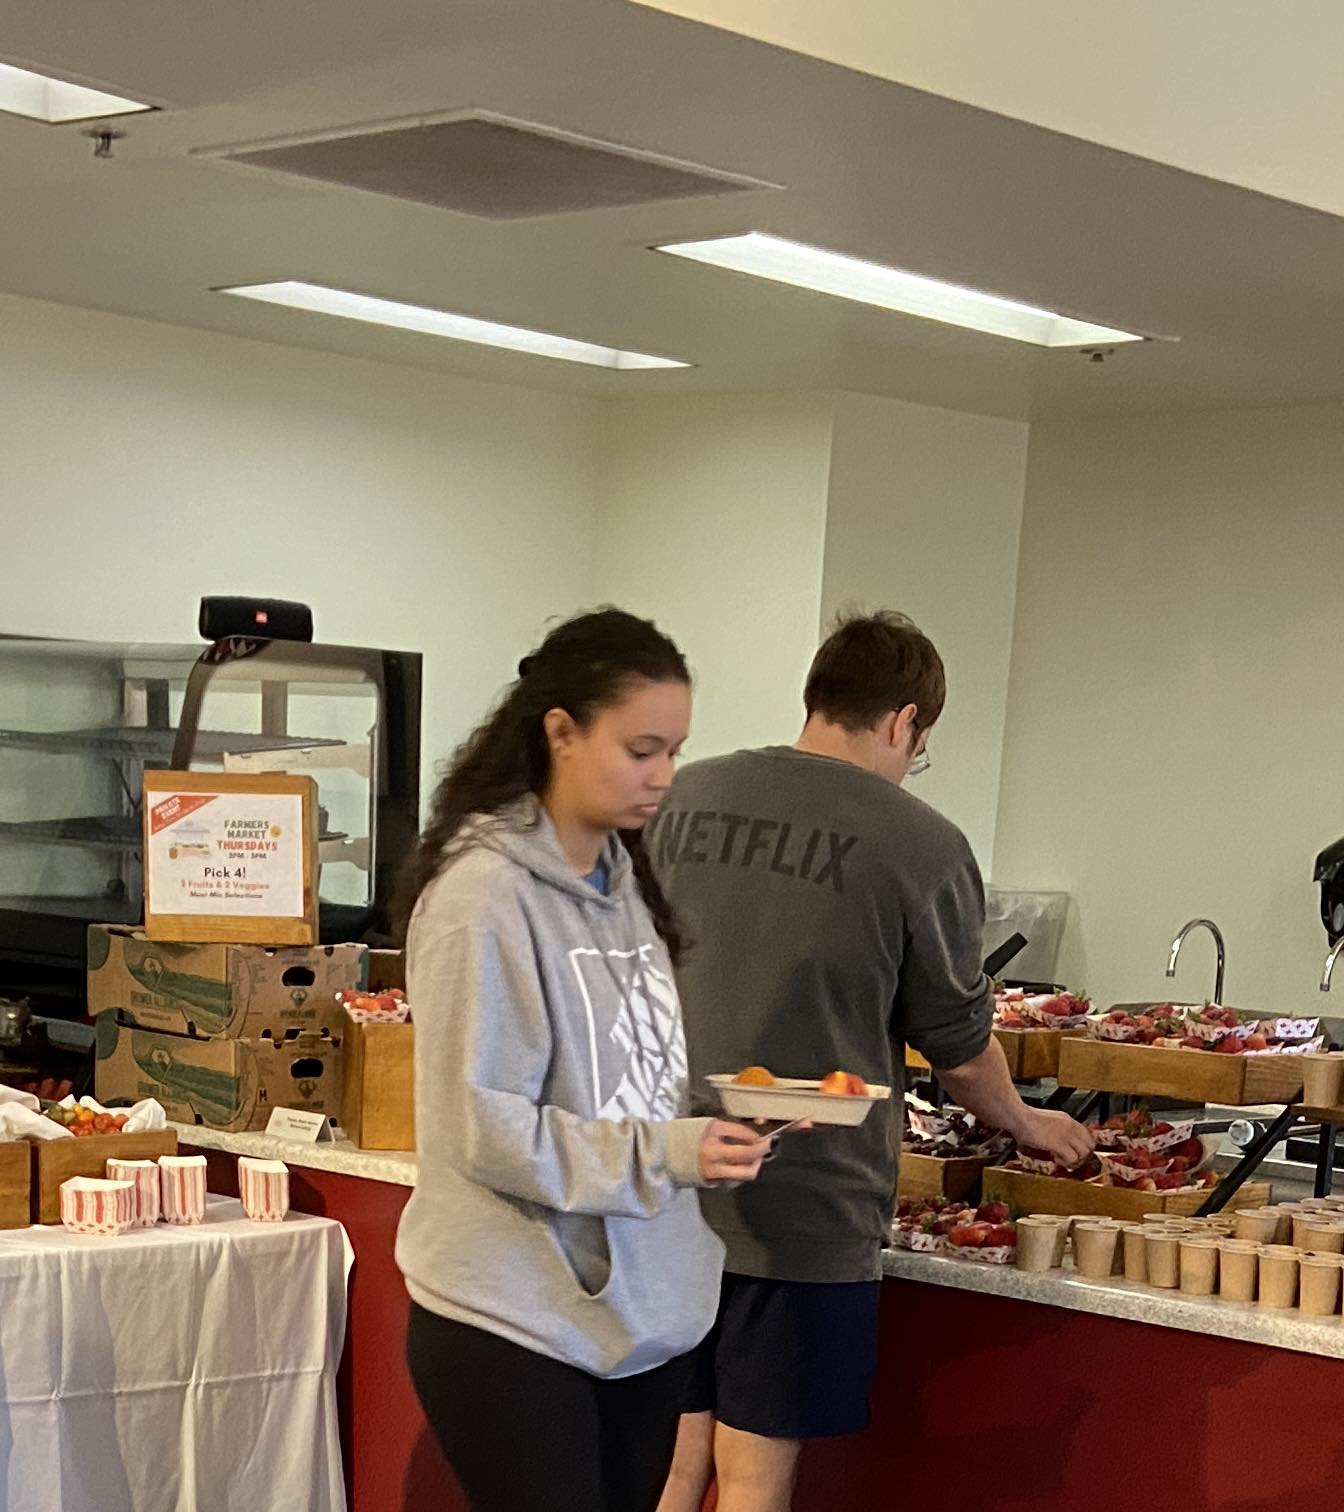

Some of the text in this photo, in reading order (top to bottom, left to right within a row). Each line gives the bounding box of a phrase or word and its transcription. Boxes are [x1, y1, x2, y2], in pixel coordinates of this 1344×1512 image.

[224, 820, 270, 829] FARMERS
[227, 830, 267, 839] MARKET
[216, 840, 277, 851] THURSDAYS
[657, 811, 858, 893] NETFLIX
[204, 867, 246, 879] Pick 4!
[188, 880, 214, 889] Fruits
[233, 881, 270, 890] Veggies
